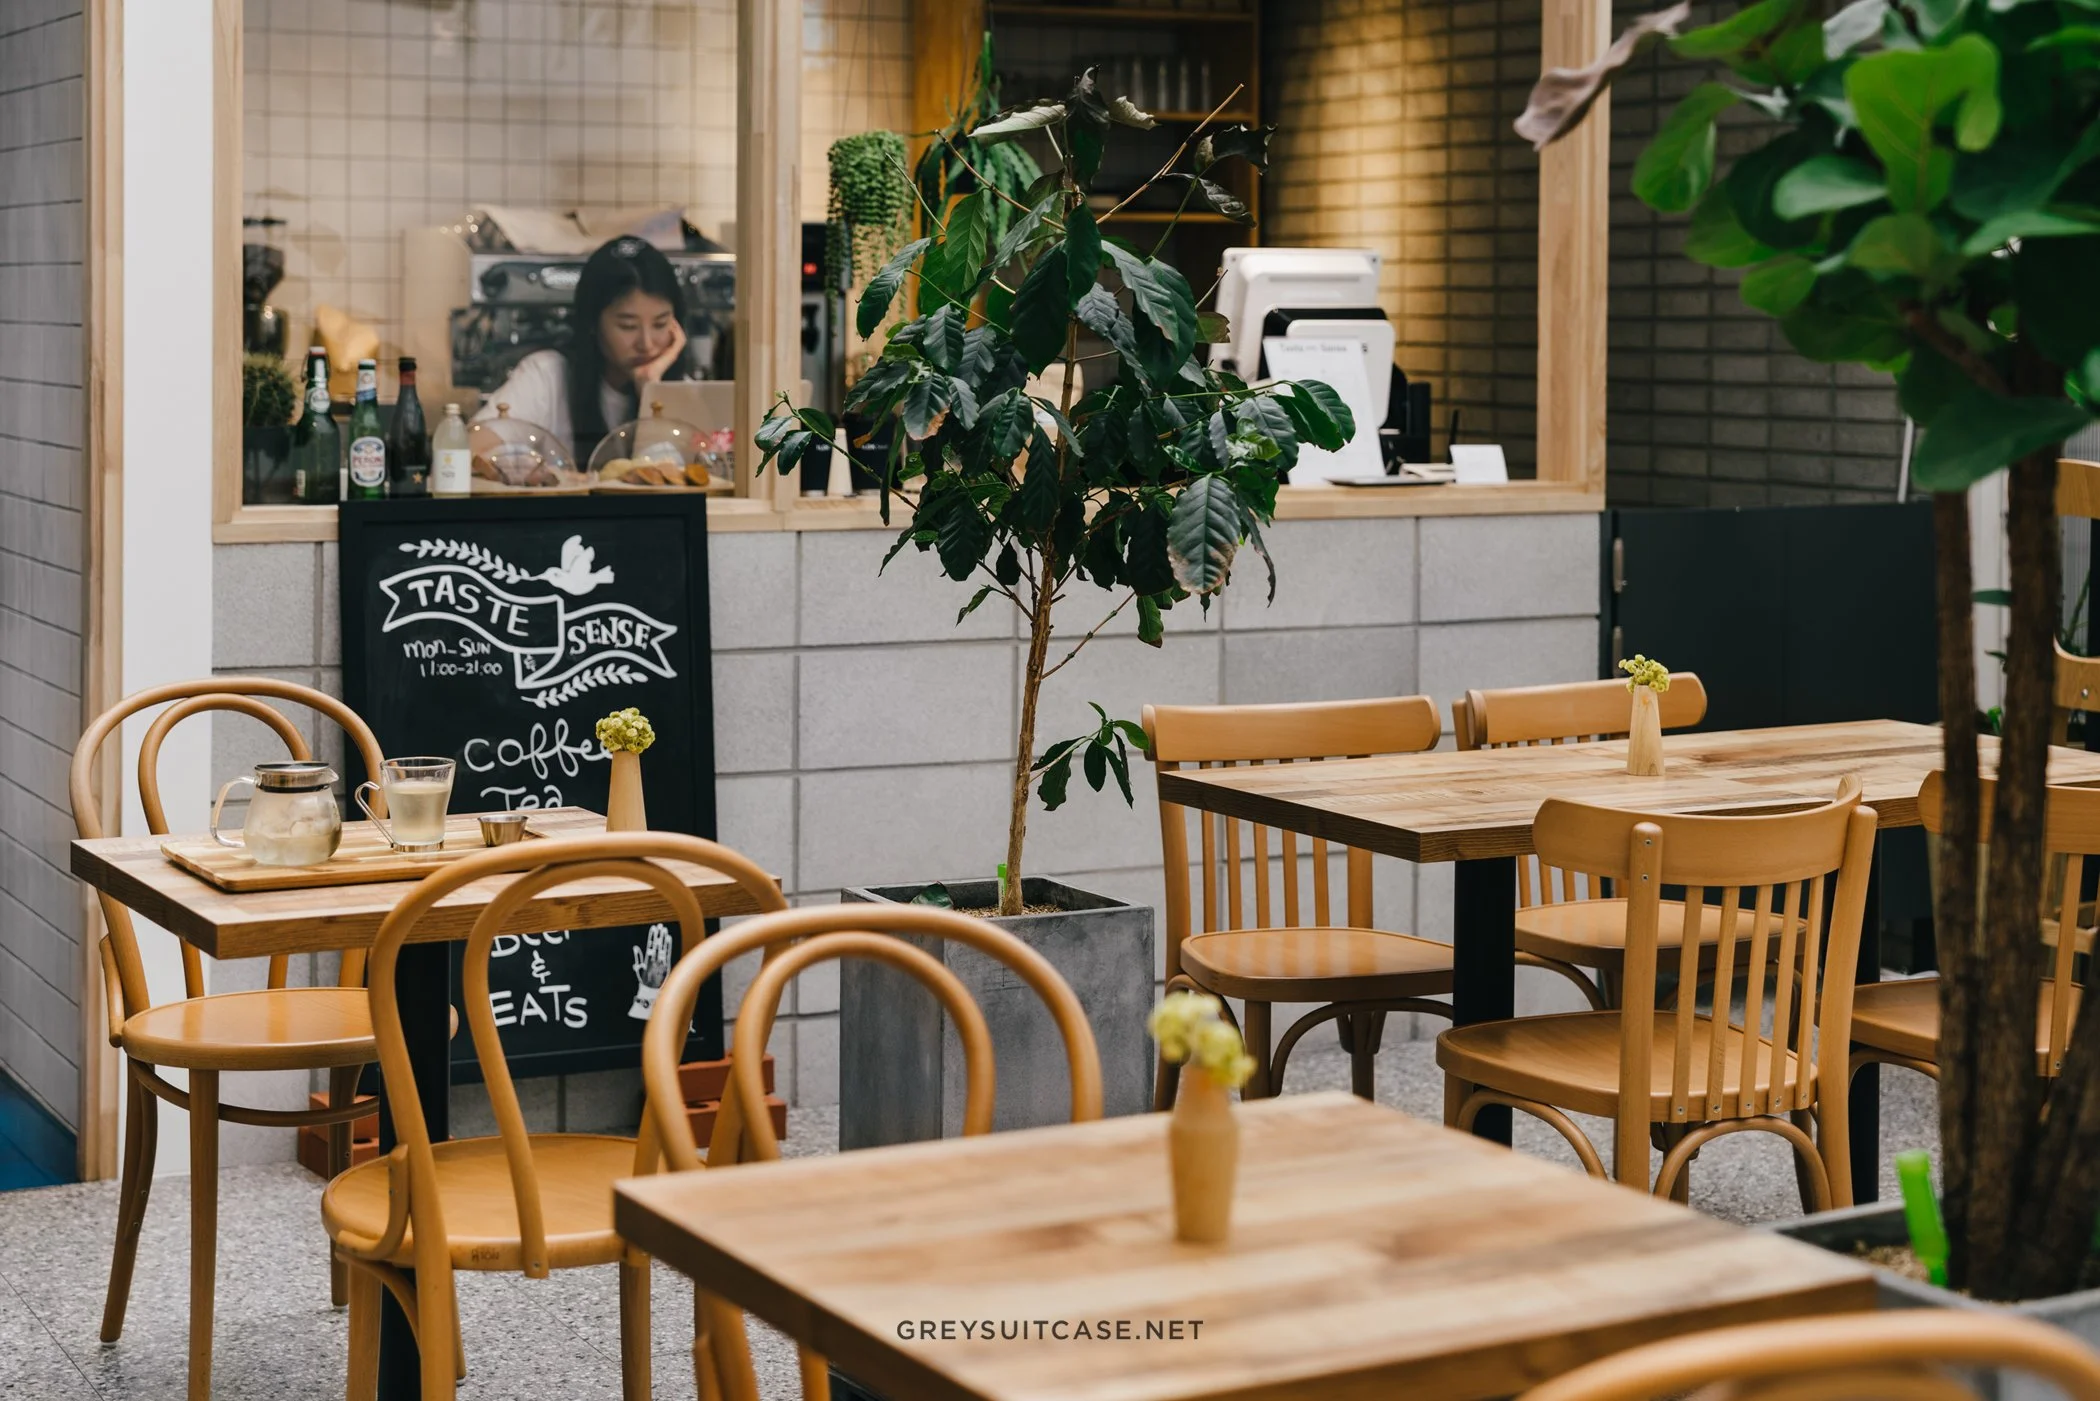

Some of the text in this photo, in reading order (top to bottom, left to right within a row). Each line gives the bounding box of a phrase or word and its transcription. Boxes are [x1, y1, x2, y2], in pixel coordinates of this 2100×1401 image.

[407, 574, 529, 637] TASTE
[567, 616, 651, 656] SENSE
[480, 784, 563, 811] Tea
[531, 949, 552, 984] &
[489, 984, 588, 1029] EATS
